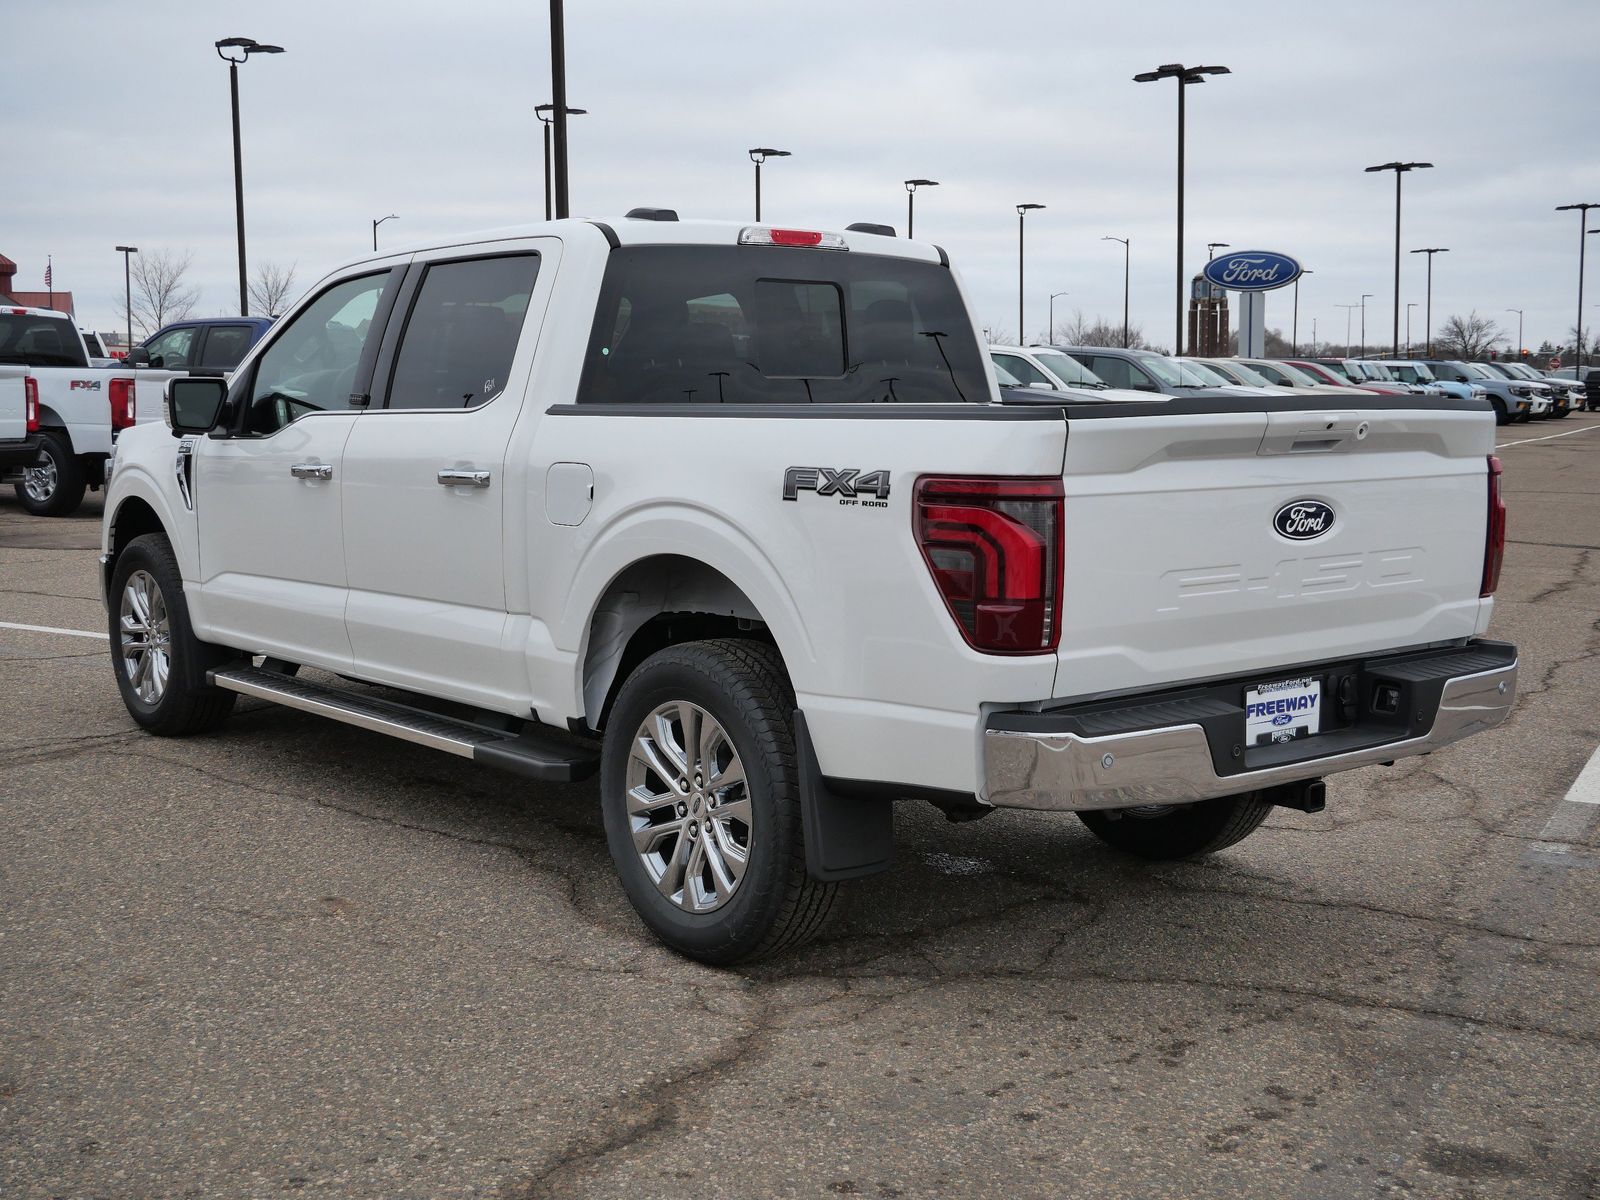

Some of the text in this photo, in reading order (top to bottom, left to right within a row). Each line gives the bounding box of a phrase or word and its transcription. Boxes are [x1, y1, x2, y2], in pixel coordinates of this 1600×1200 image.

[1222, 258, 1280, 282] Ford
[70, 380, 101, 391] FX4
[782, 466, 891, 501] FX4
[861, 500, 888, 508] ROAD
[1286, 505, 1326, 533] Ford
[1246, 693, 1319, 719] FREEWAY
